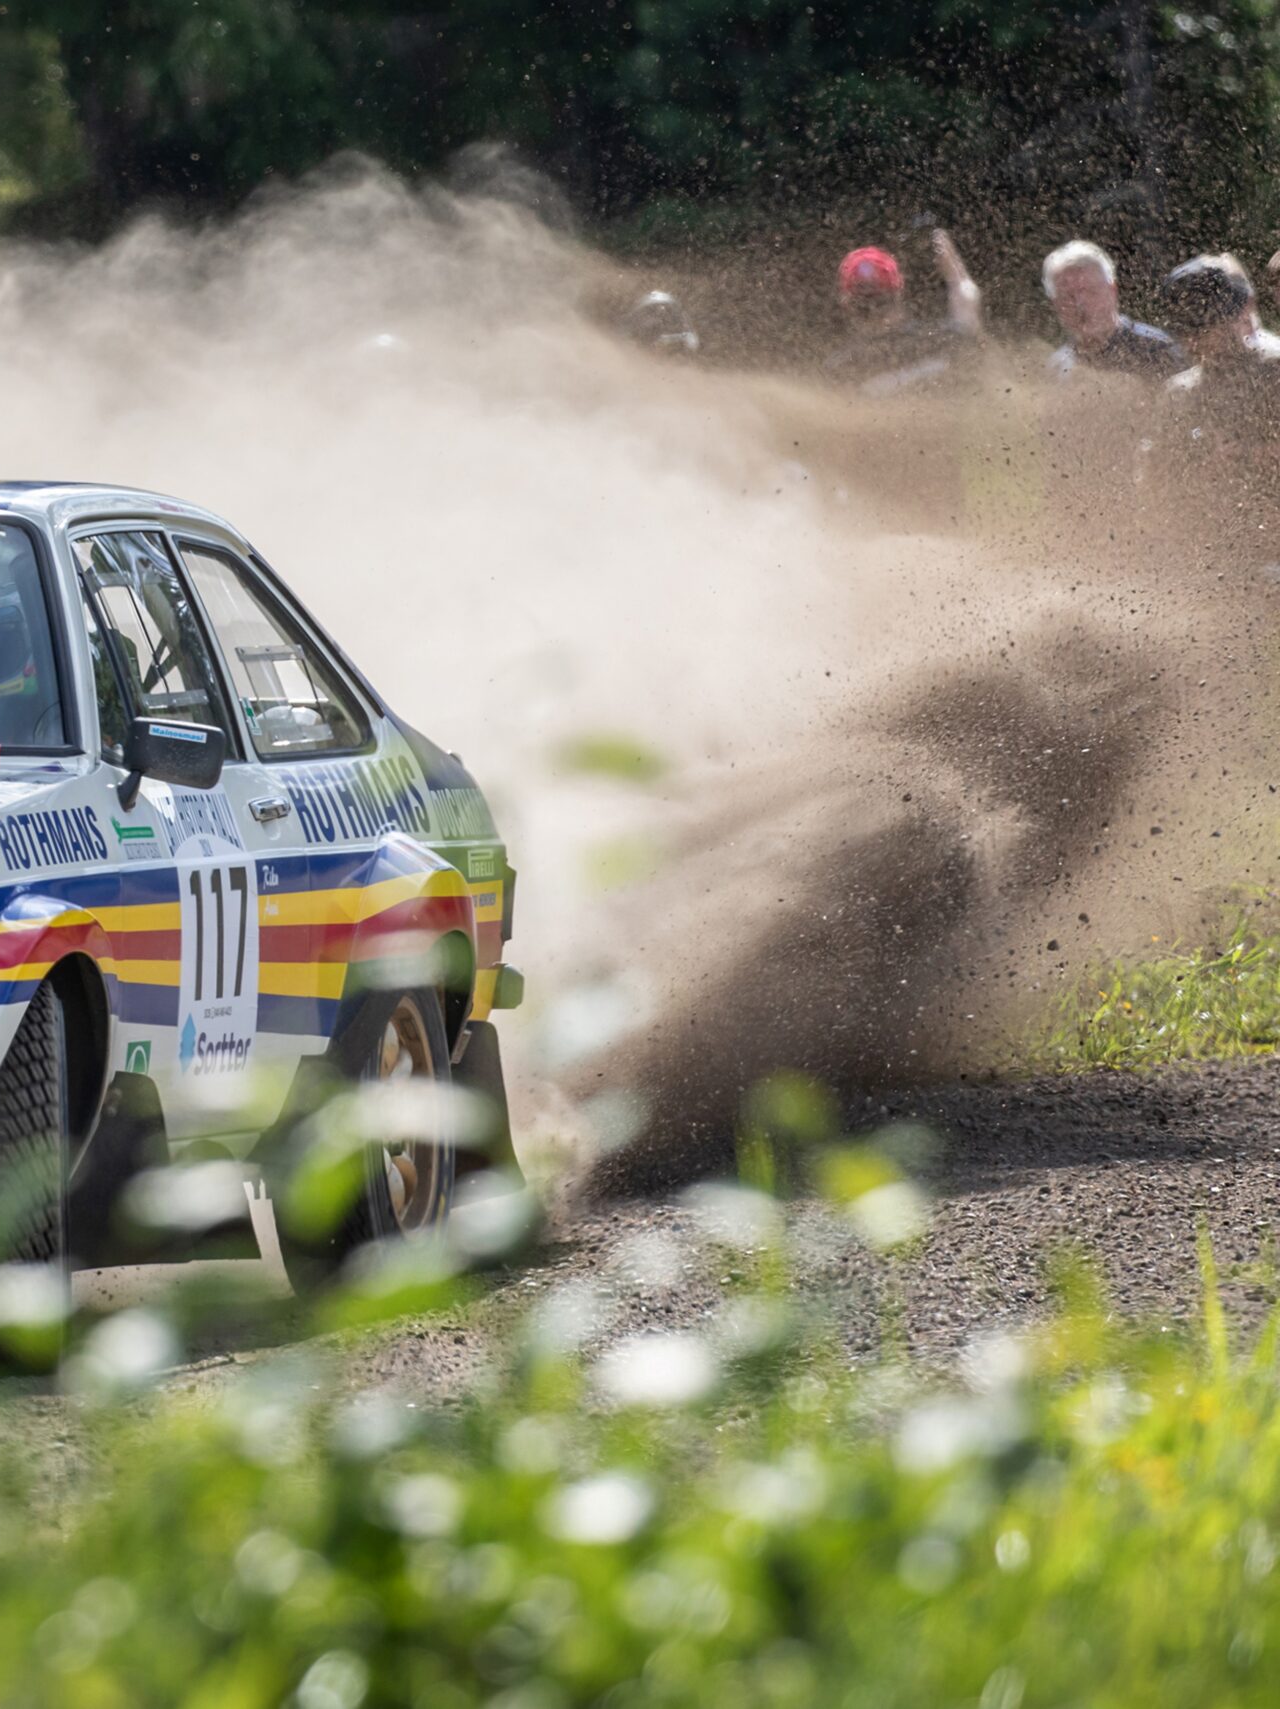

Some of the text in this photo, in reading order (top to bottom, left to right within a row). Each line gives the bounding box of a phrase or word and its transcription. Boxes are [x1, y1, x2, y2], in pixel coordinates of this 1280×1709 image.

[280, 755, 431, 843] ROTHMANS
[467, 848, 495, 878] PIRELLI
[189, 866, 248, 1001] 117
[194, 1032, 252, 1077] Sortter
